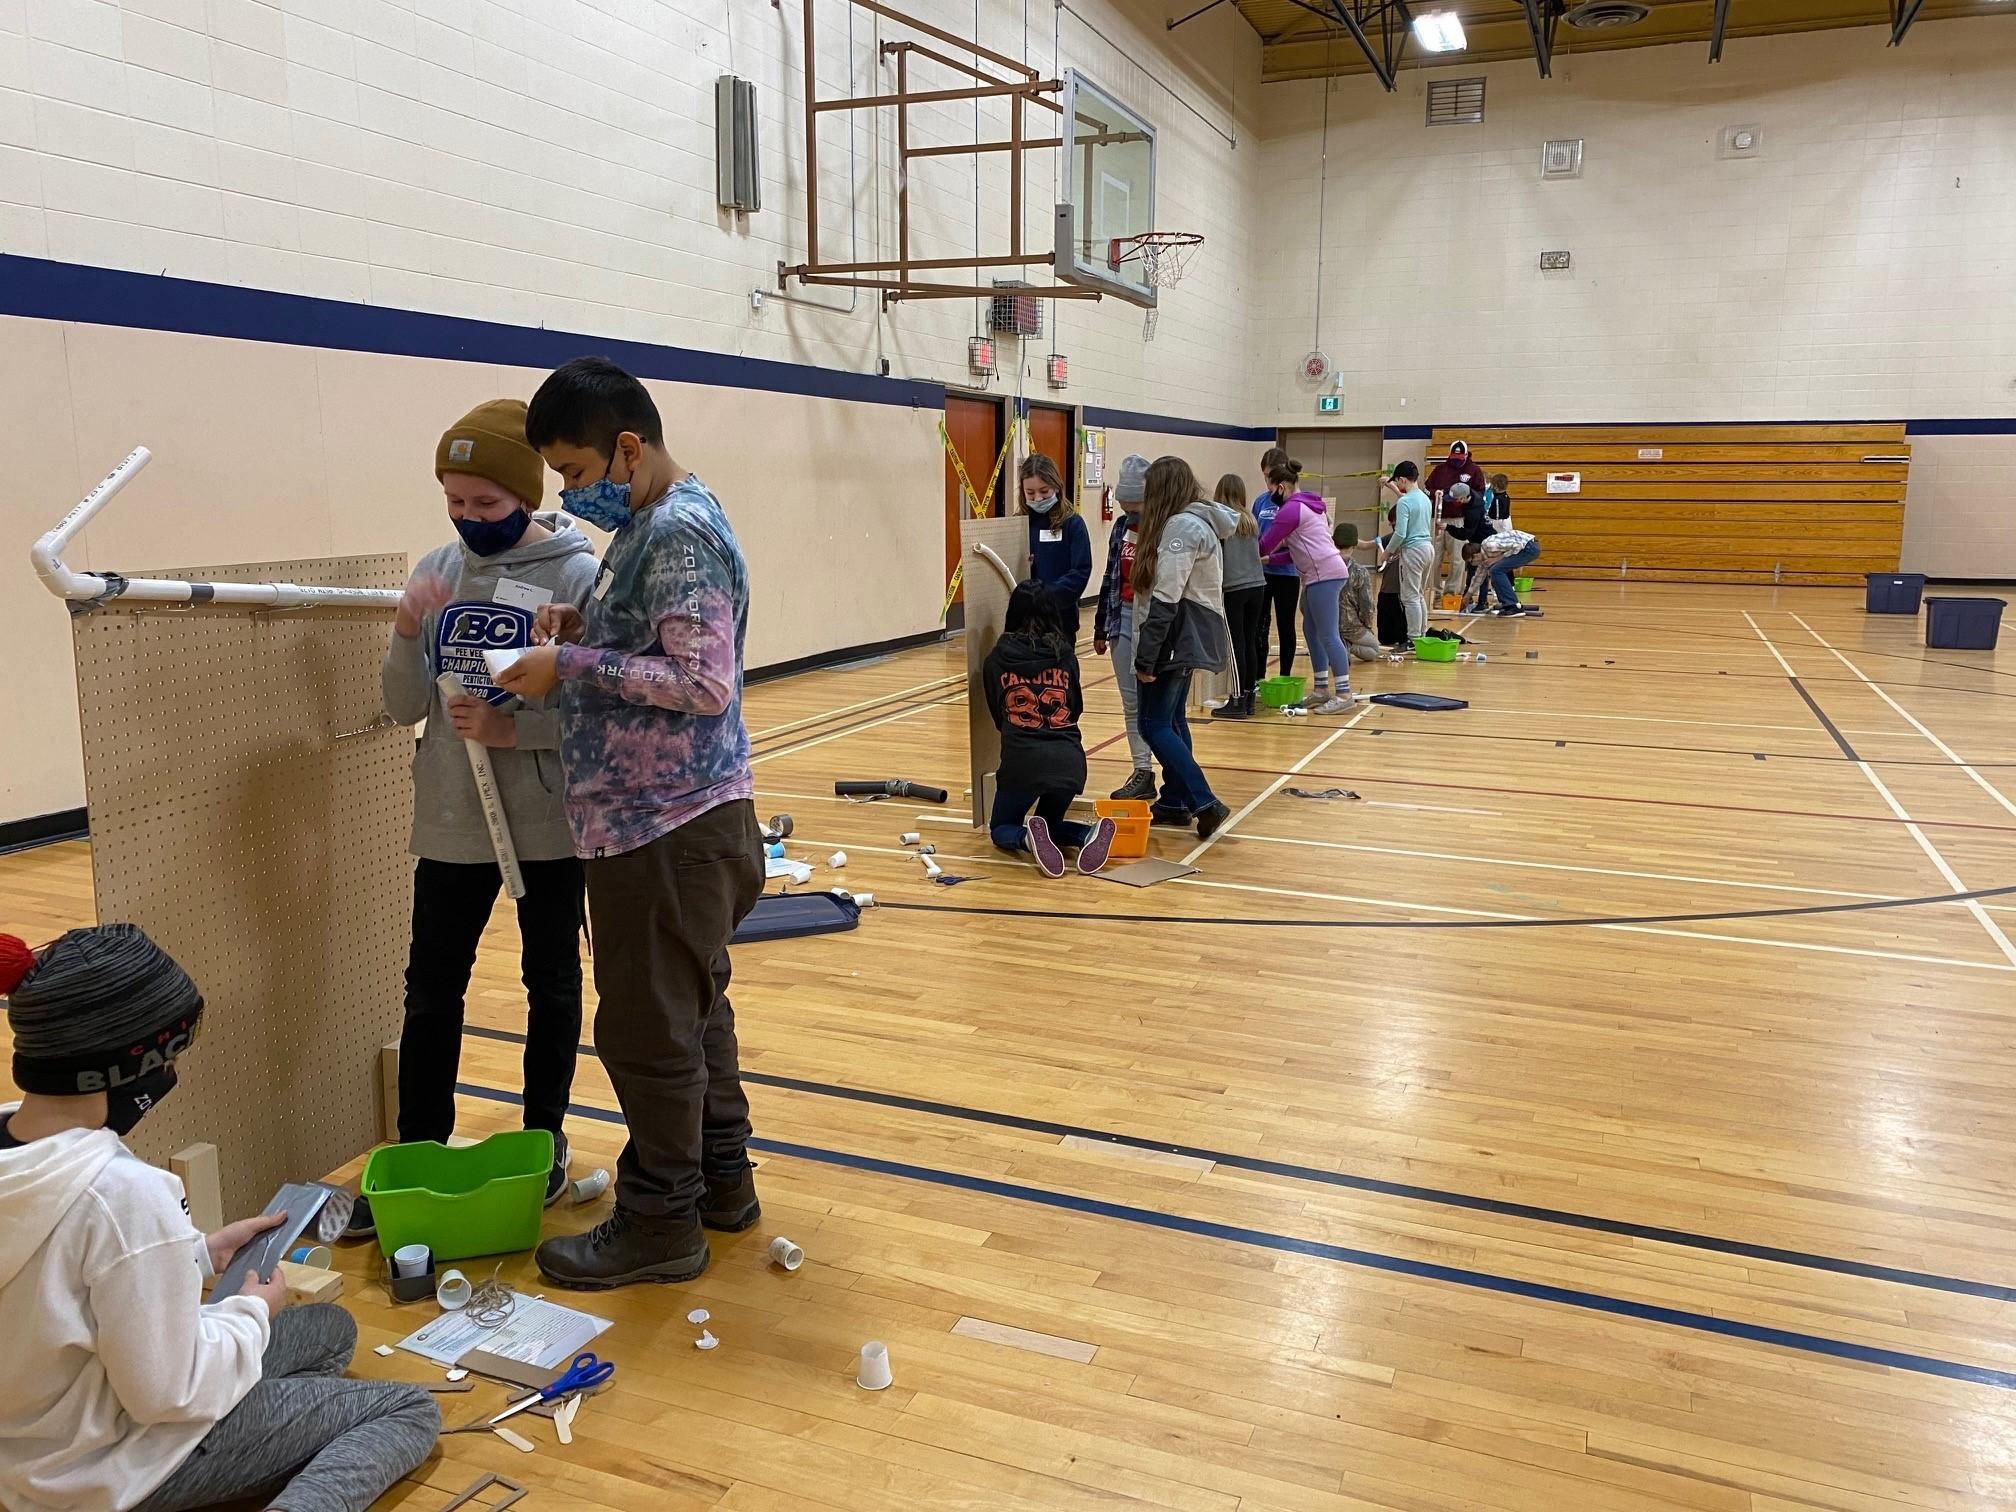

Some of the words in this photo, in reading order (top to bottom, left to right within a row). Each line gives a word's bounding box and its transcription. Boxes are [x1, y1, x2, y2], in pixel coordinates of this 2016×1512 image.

[683, 544, 697, 583] ZOO
[687, 587, 702, 634] YORK
[455, 611, 518, 646] BC
[455, 647, 469, 657] PEE
[441, 657, 489, 674] CHAMPIO
[630, 669, 666, 682] ZOO
[468, 686, 488, 698] 020
[1005, 685, 1077, 730] 82
[134, 1093, 153, 1112] ZO
